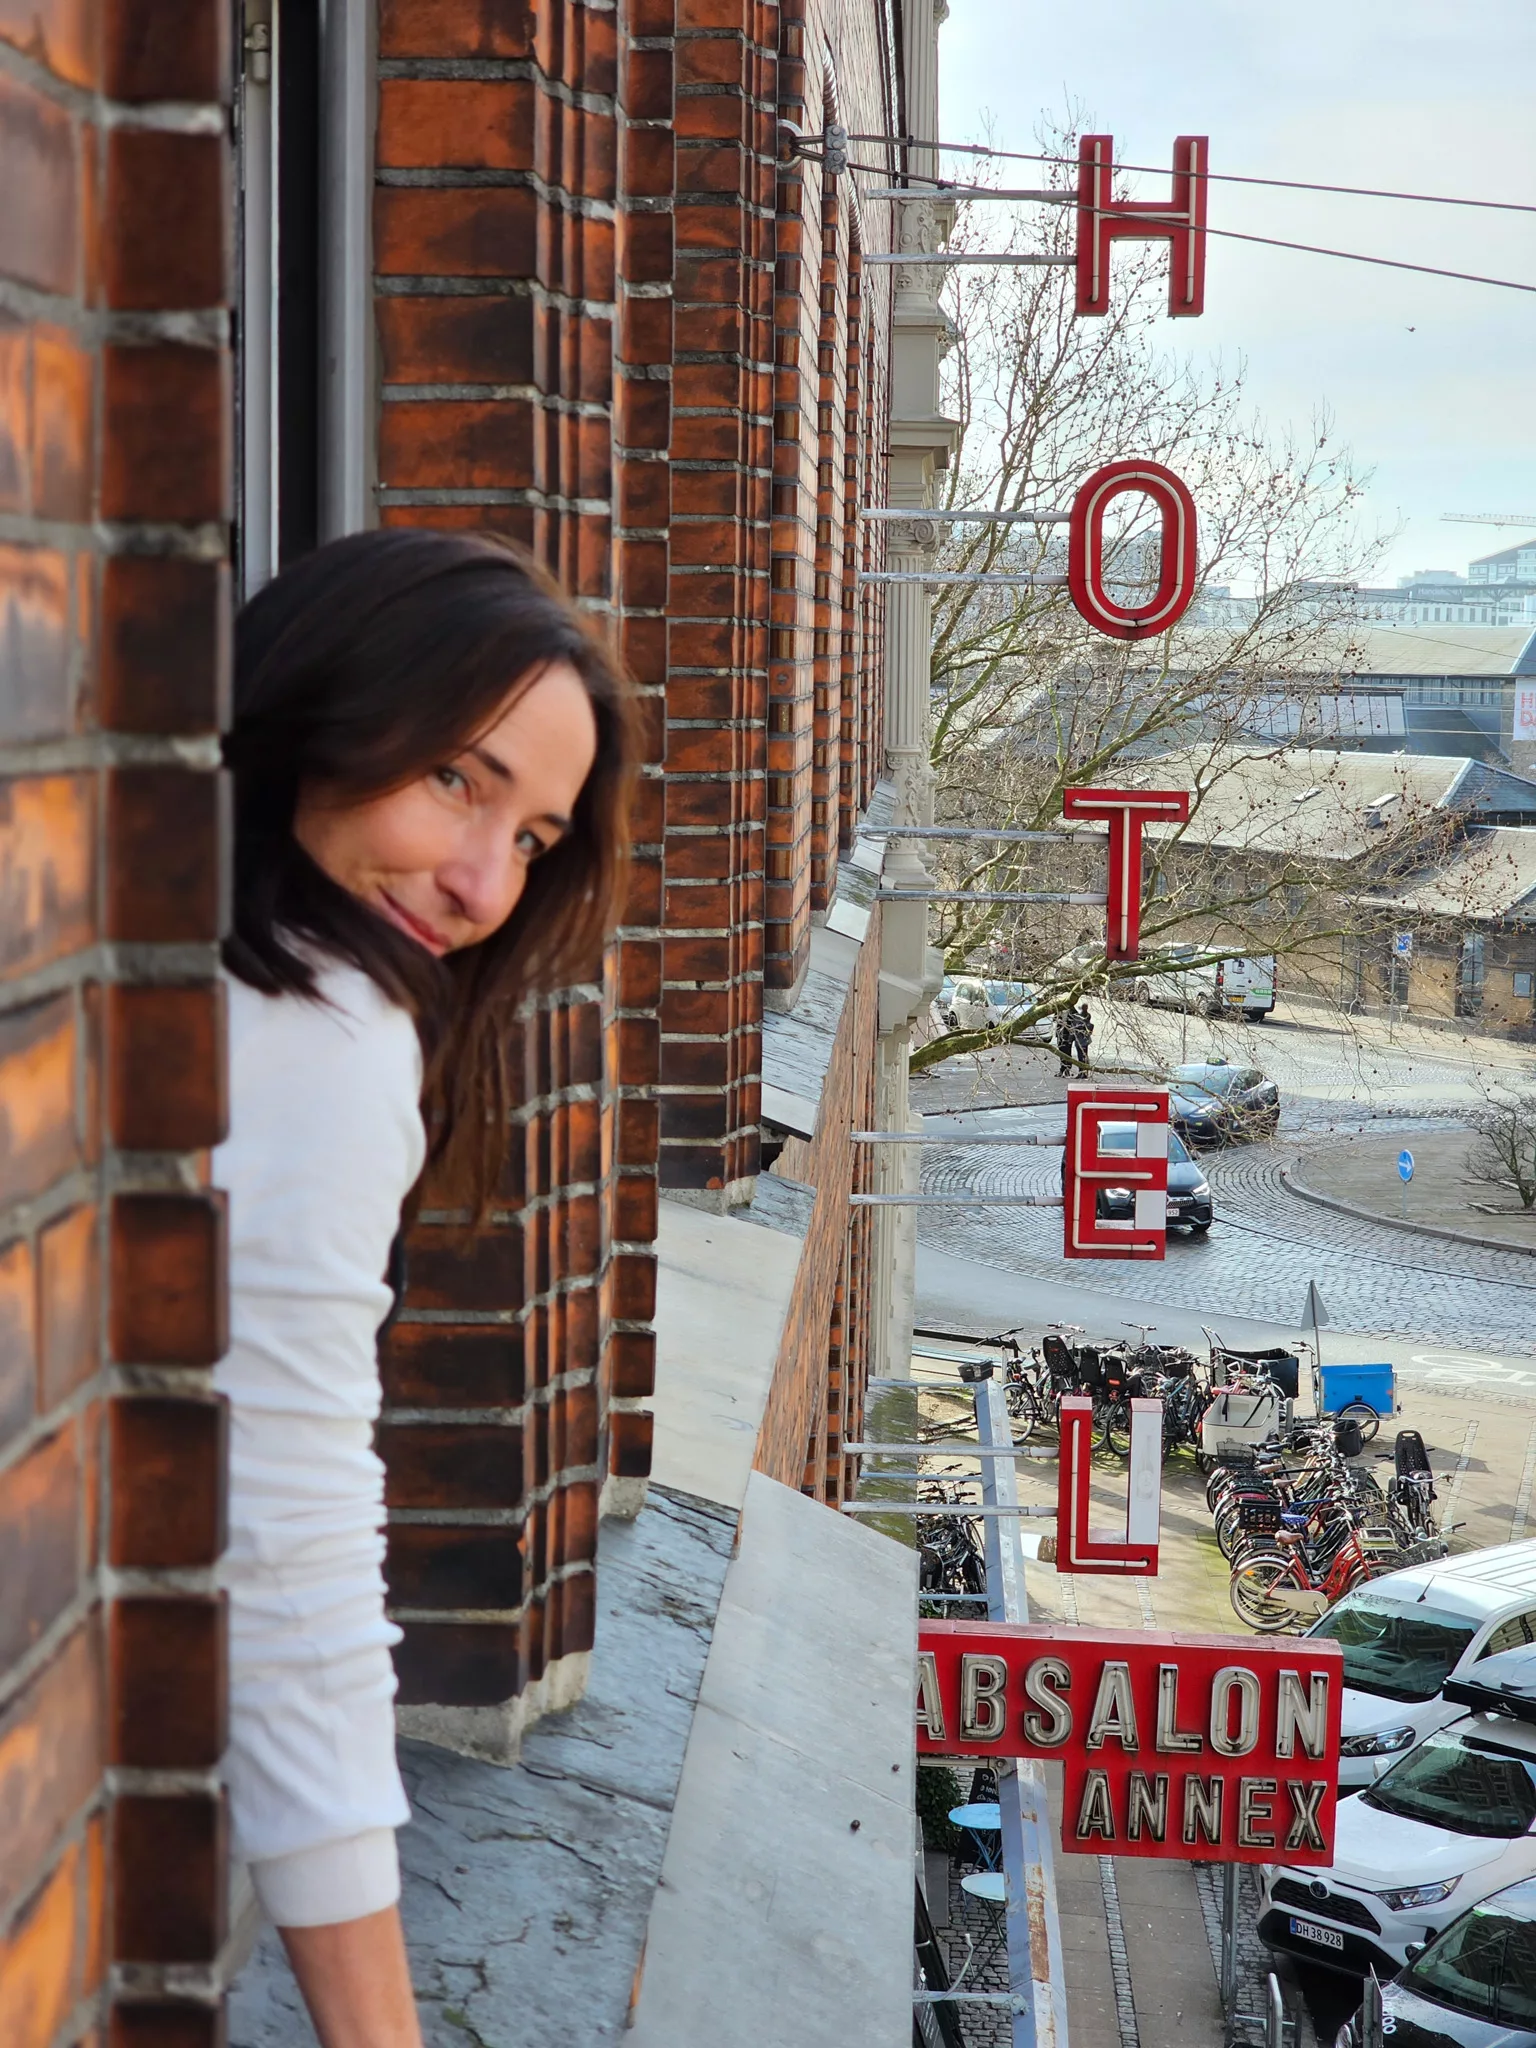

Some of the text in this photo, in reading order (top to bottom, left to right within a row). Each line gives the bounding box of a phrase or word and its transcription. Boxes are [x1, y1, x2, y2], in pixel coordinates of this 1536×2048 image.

[1057, 135, 1209, 1576] HOTEL
[917, 1651, 1329, 1760] ABSALON
[1076, 1769, 1327, 1852] ANNEX
[1296, 1923, 1342, 1947] DH 38 928
